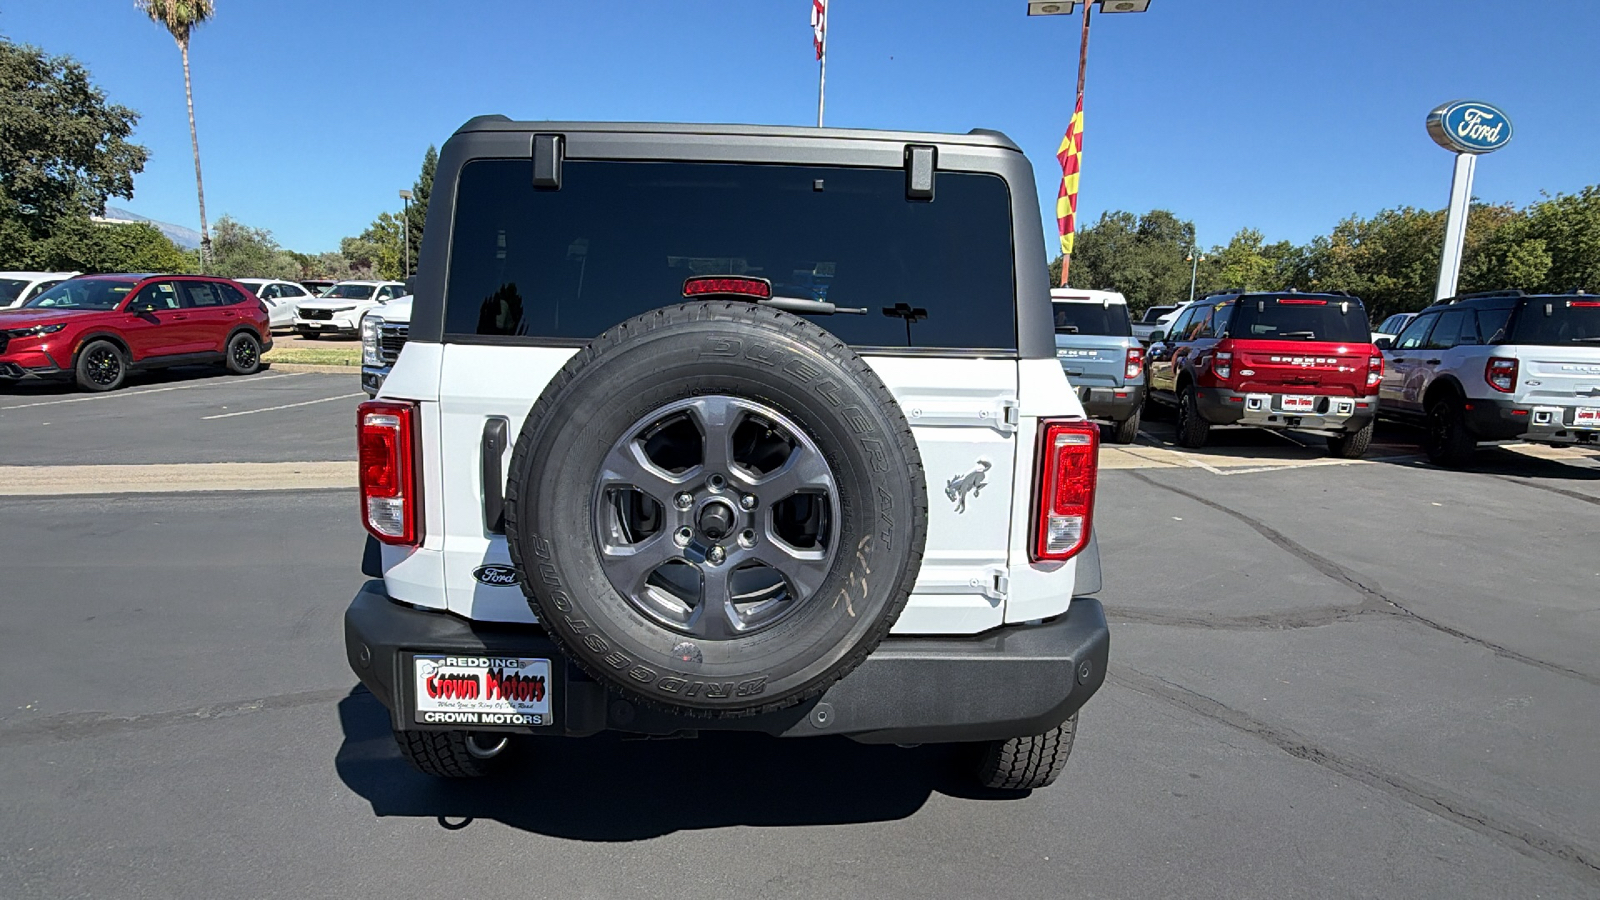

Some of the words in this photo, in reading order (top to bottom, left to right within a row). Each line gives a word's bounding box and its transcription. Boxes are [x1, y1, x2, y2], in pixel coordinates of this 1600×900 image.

[1457, 108, 1503, 143] Ford
[698, 335, 889, 474] DUELER
[877, 486, 894, 551] A/T
[481, 567, 516, 583] Ford
[532, 534, 771, 699] BRIDGESTONE
[446, 657, 518, 668] REDDING
[426, 672, 480, 700] Crown
[486, 667, 546, 702] Motors
[477, 701, 493, 709] King
[424, 712, 479, 723] CROWN
[481, 713, 542, 724] MOTORS
